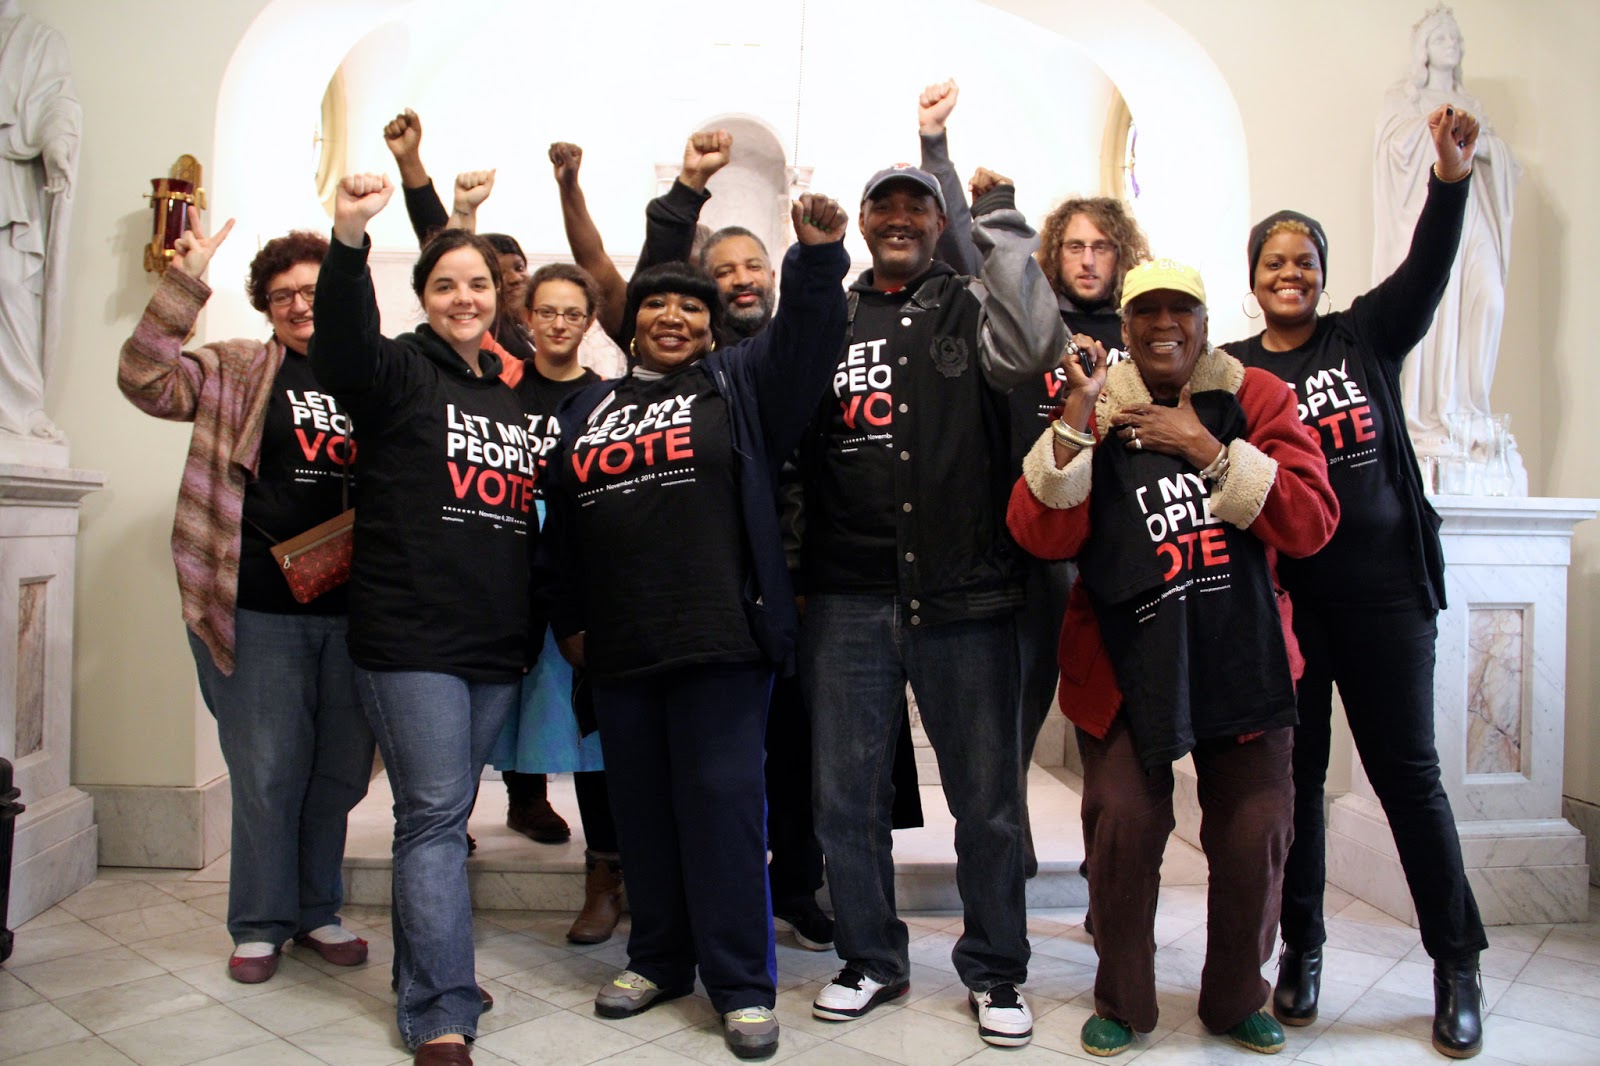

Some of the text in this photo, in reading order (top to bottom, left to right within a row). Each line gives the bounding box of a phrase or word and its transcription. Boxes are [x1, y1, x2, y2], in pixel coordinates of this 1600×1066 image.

[833, 364, 892, 398] PEO
[1305, 358, 1348, 395] MY
[286, 390, 336, 413] LET
[587, 394, 697, 434] LET MY
[292, 406, 354, 435] PEO
[447, 404, 490, 439] LET
[574, 404, 692, 450] PEOPLE
[294, 428, 357, 466] VO
[447, 432, 535, 476] PEOPLE
[571, 426, 694, 483] VOTE
[1330, 455, 1344, 465] 2014
[447, 461, 534, 514] VOTE
[606, 479, 633, 491] November
[641, 473, 656, 482] 2014
